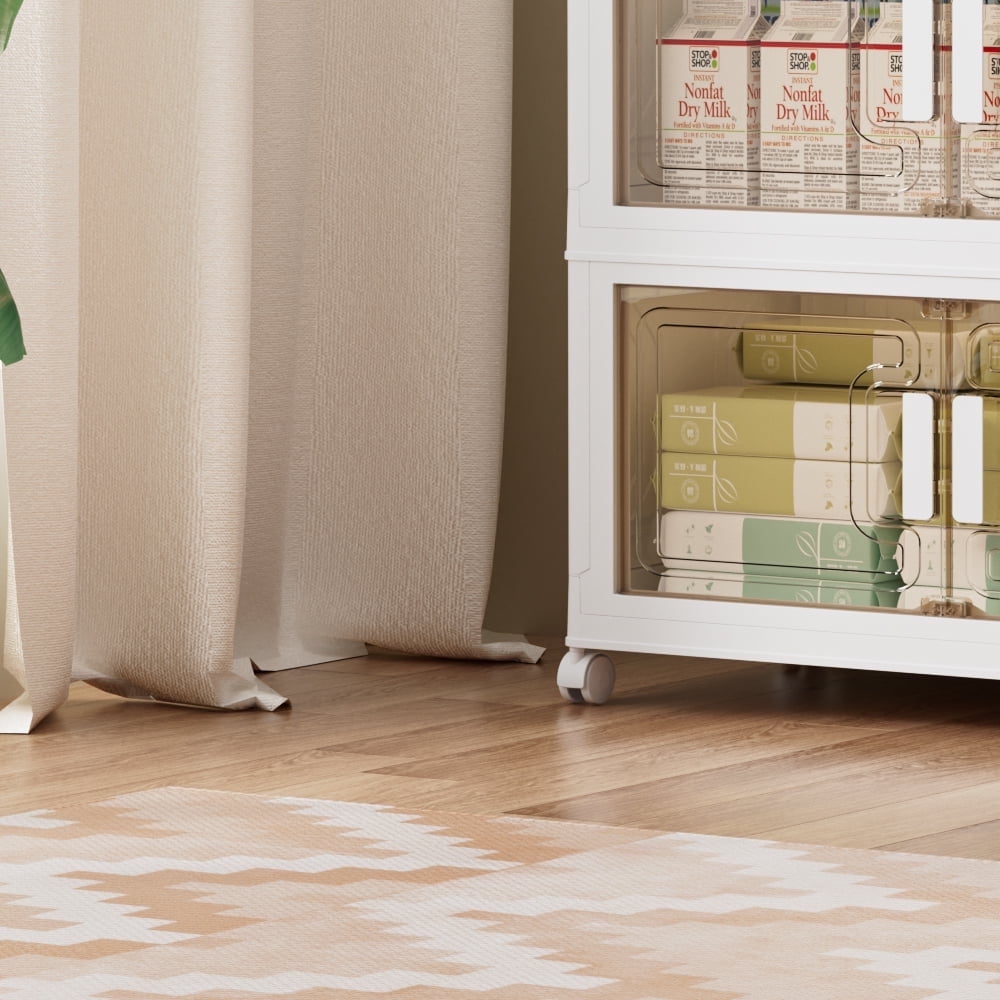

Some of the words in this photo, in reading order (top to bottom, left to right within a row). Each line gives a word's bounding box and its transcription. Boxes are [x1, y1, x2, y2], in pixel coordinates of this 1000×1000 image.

[691, 50, 710, 59] STOP
[790, 53, 808, 61] STOP
[691, 59, 710, 68] SHOP
[790, 62, 809, 70] SHOP
[684, 82, 725, 100] Nonfat
[783, 84, 823, 102] Nonfat
[678, 100, 701, 122] Dry
[704, 100, 731, 118] Milk
[776, 103, 798, 125] Dry
[802, 103, 830, 121] Milk
